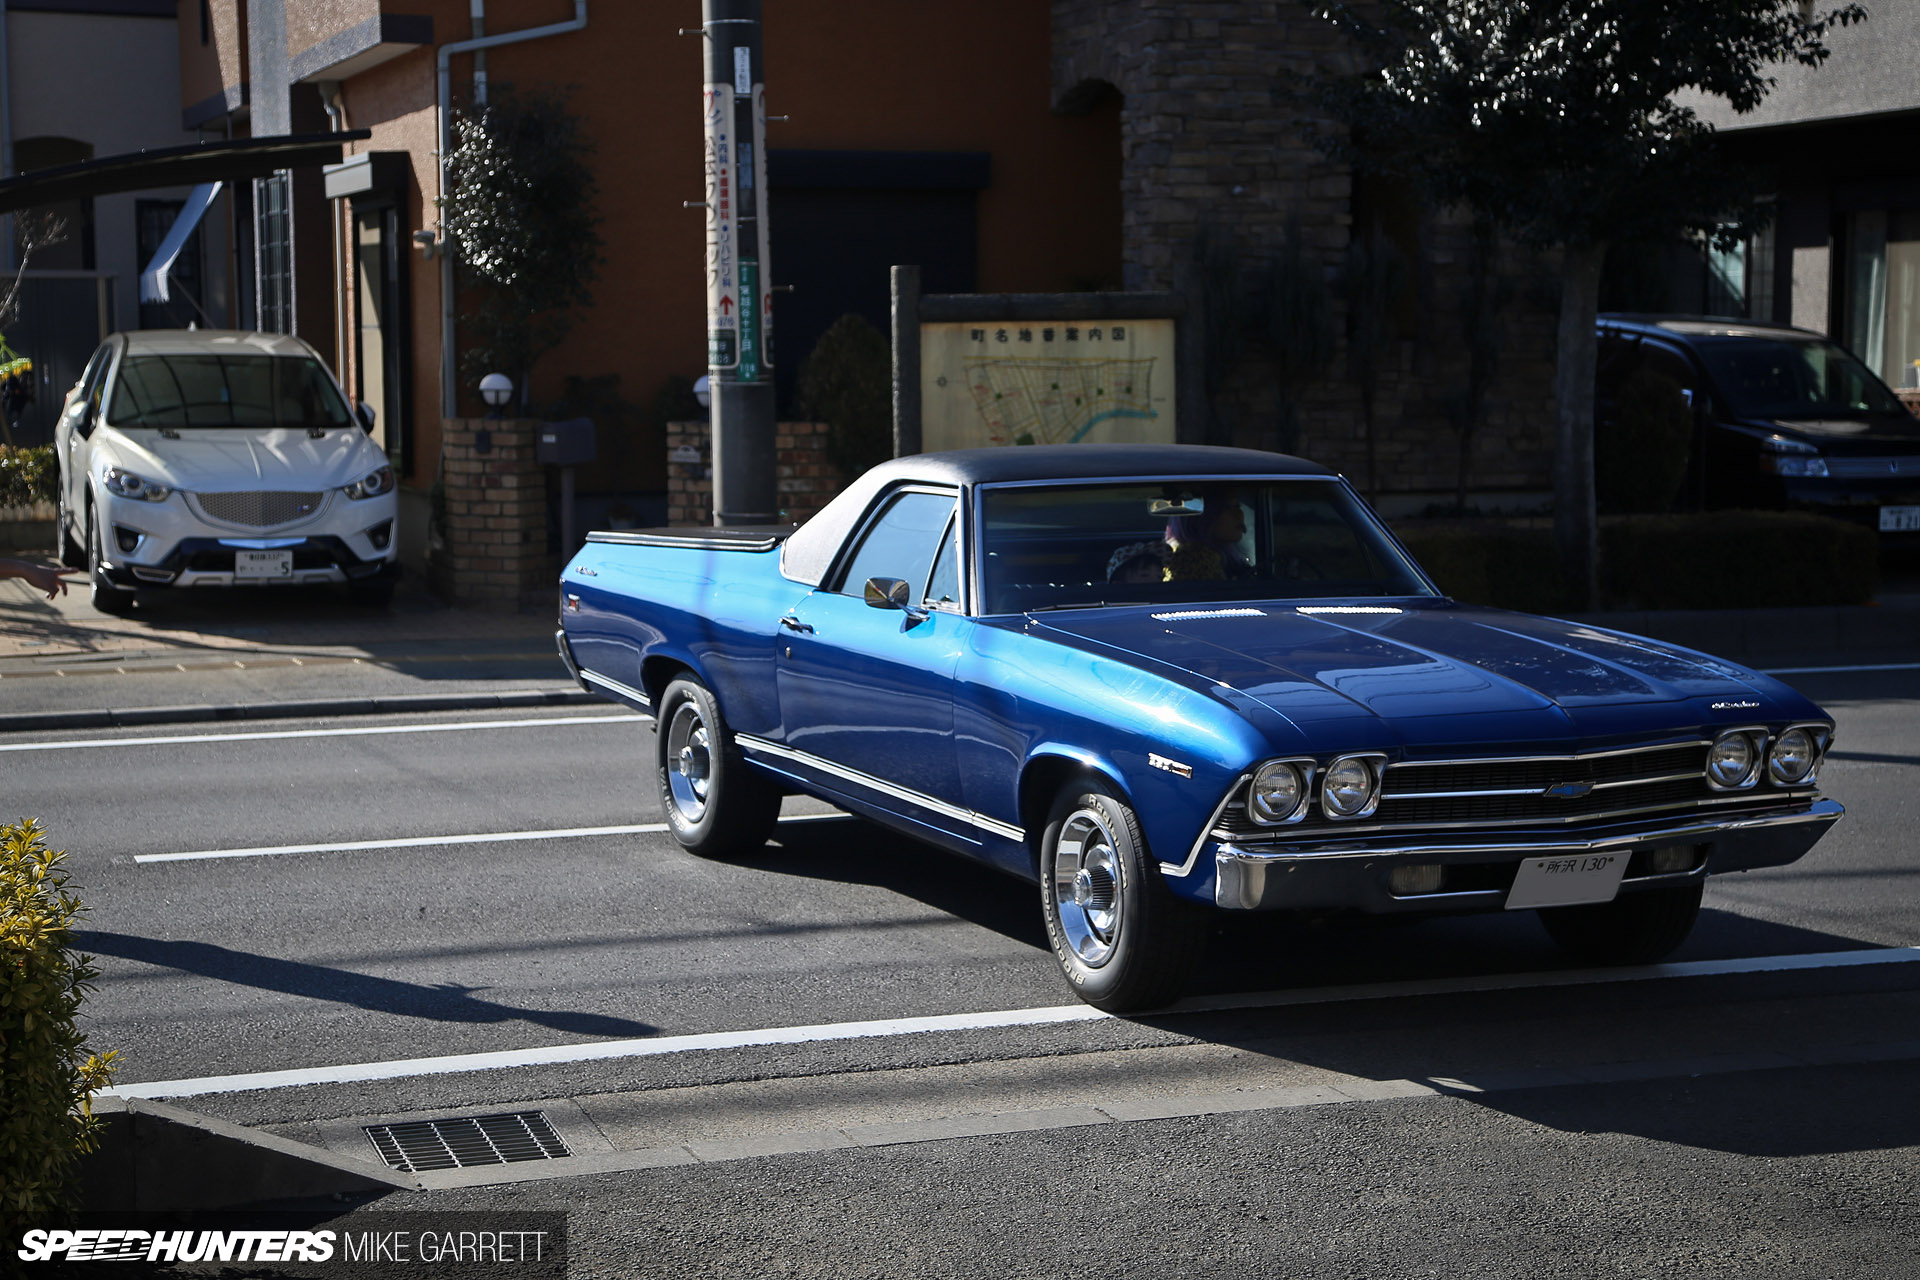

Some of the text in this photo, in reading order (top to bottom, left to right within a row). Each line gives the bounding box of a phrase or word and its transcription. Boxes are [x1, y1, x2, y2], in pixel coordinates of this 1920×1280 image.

[970, 327, 1126, 343] 町名地番案内図
[1088, 793, 1121, 847] Radial
[1545, 856, 1607, 874] 所沢 130
